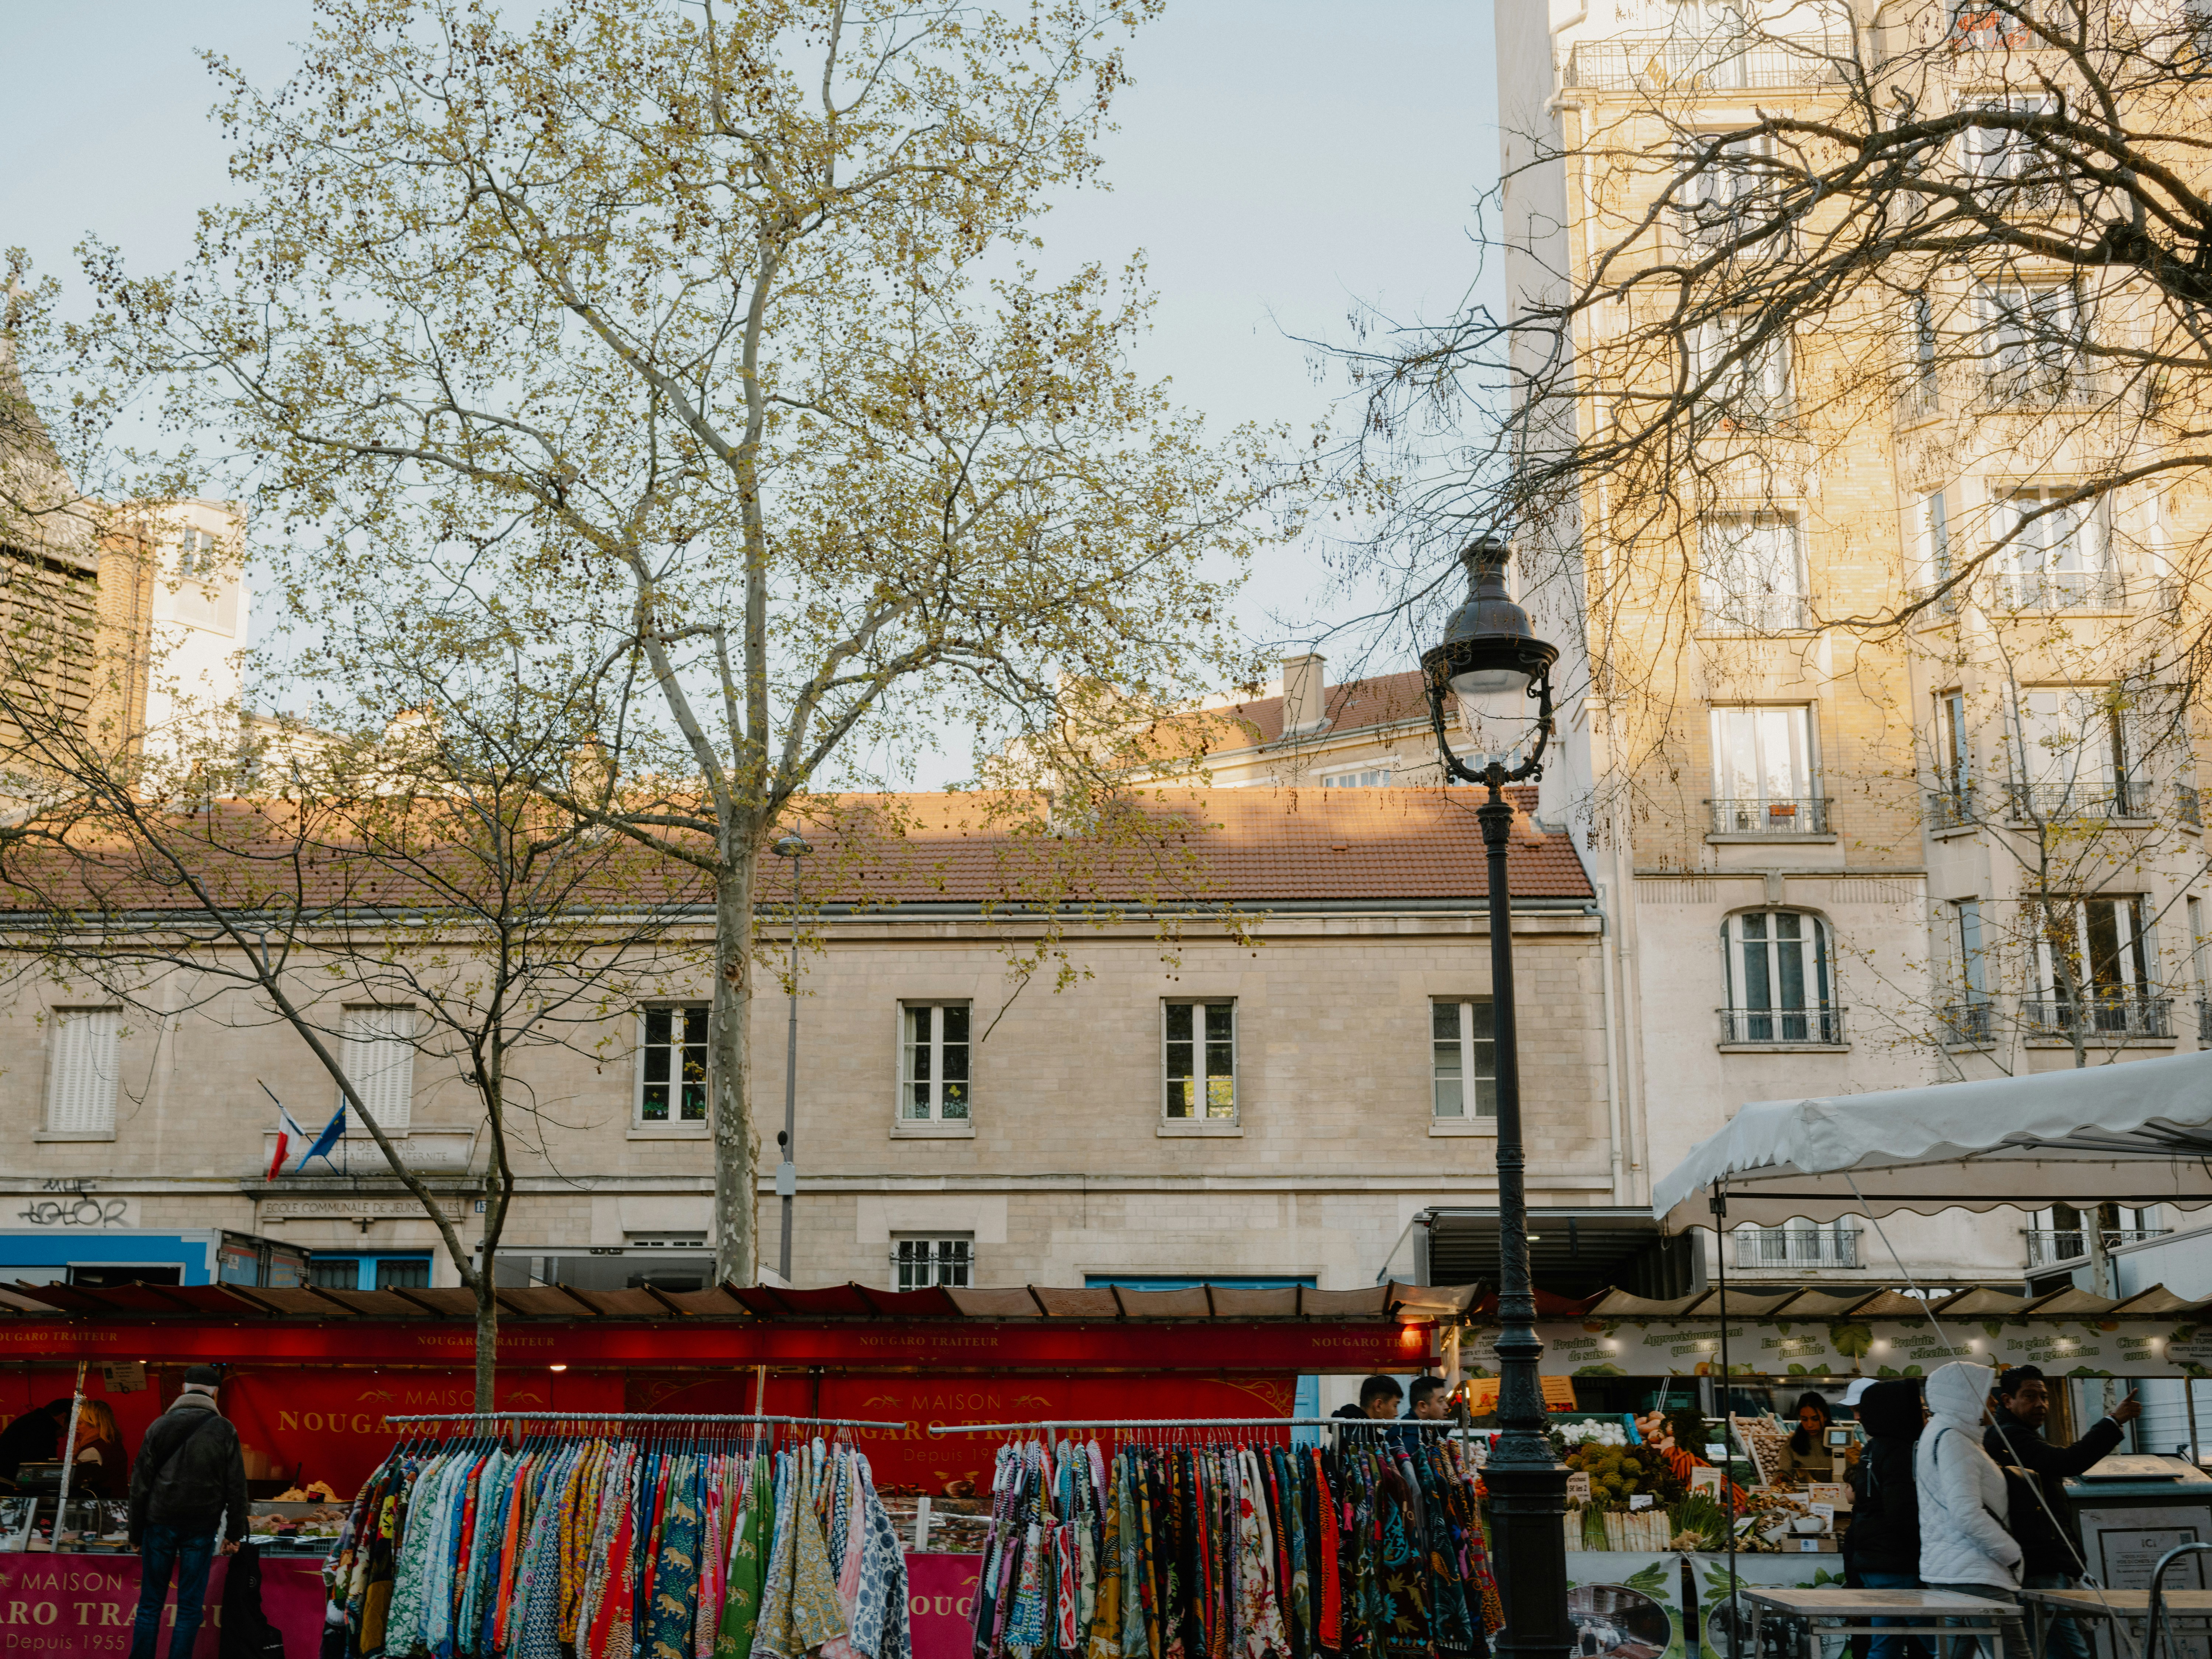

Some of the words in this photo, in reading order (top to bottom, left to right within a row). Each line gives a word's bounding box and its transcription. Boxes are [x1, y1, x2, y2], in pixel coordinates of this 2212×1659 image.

[267, 1203, 298, 1213] ECOLE
[302, 1203, 368, 1213] COMMUNALE
[374, 1203, 387, 1212] DE
[390, 1203, 427, 1213] JEUNES
[52, 1332, 117, 1341] TRAITEUR
[497, 1336, 554, 1346] RAITEUR
[859, 1337, 925, 1346] NOUGARO
[930, 1337, 999, 1346] TRAITEUR
[1312, 1338, 1380, 1347] NOUGARO
[1552, 1336, 1597, 1350] Produits
[1761, 1335, 1816, 1349] Entreprise
[1891, 1334, 1935, 1348] Produits
[2007, 1339, 2023, 1350] De
[2024, 1334, 2081, 1351] génération
[2116, 1335, 2153, 1349] Circuit
[1568, 1350, 1581, 1361] de
[1583, 1348, 1616, 1361] saison
[1671, 1342, 1719, 1357] quotidien
[1778, 1343, 1825, 1361] familiale
[2028, 1352, 2042, 1361] en
[2043, 1345, 2100, 1363] génération
[2124, 1349, 2152, 1361] court
[405, 1390, 476, 1406] MAISO
[912, 1394, 1001, 1410] MAISON
[903, 1448, 962, 1464] Depuis
[21, 1572, 122, 1591] MAISON
[6, 1633, 73, 1652] Depuis
[83, 1635, 125, 1650] 1955
